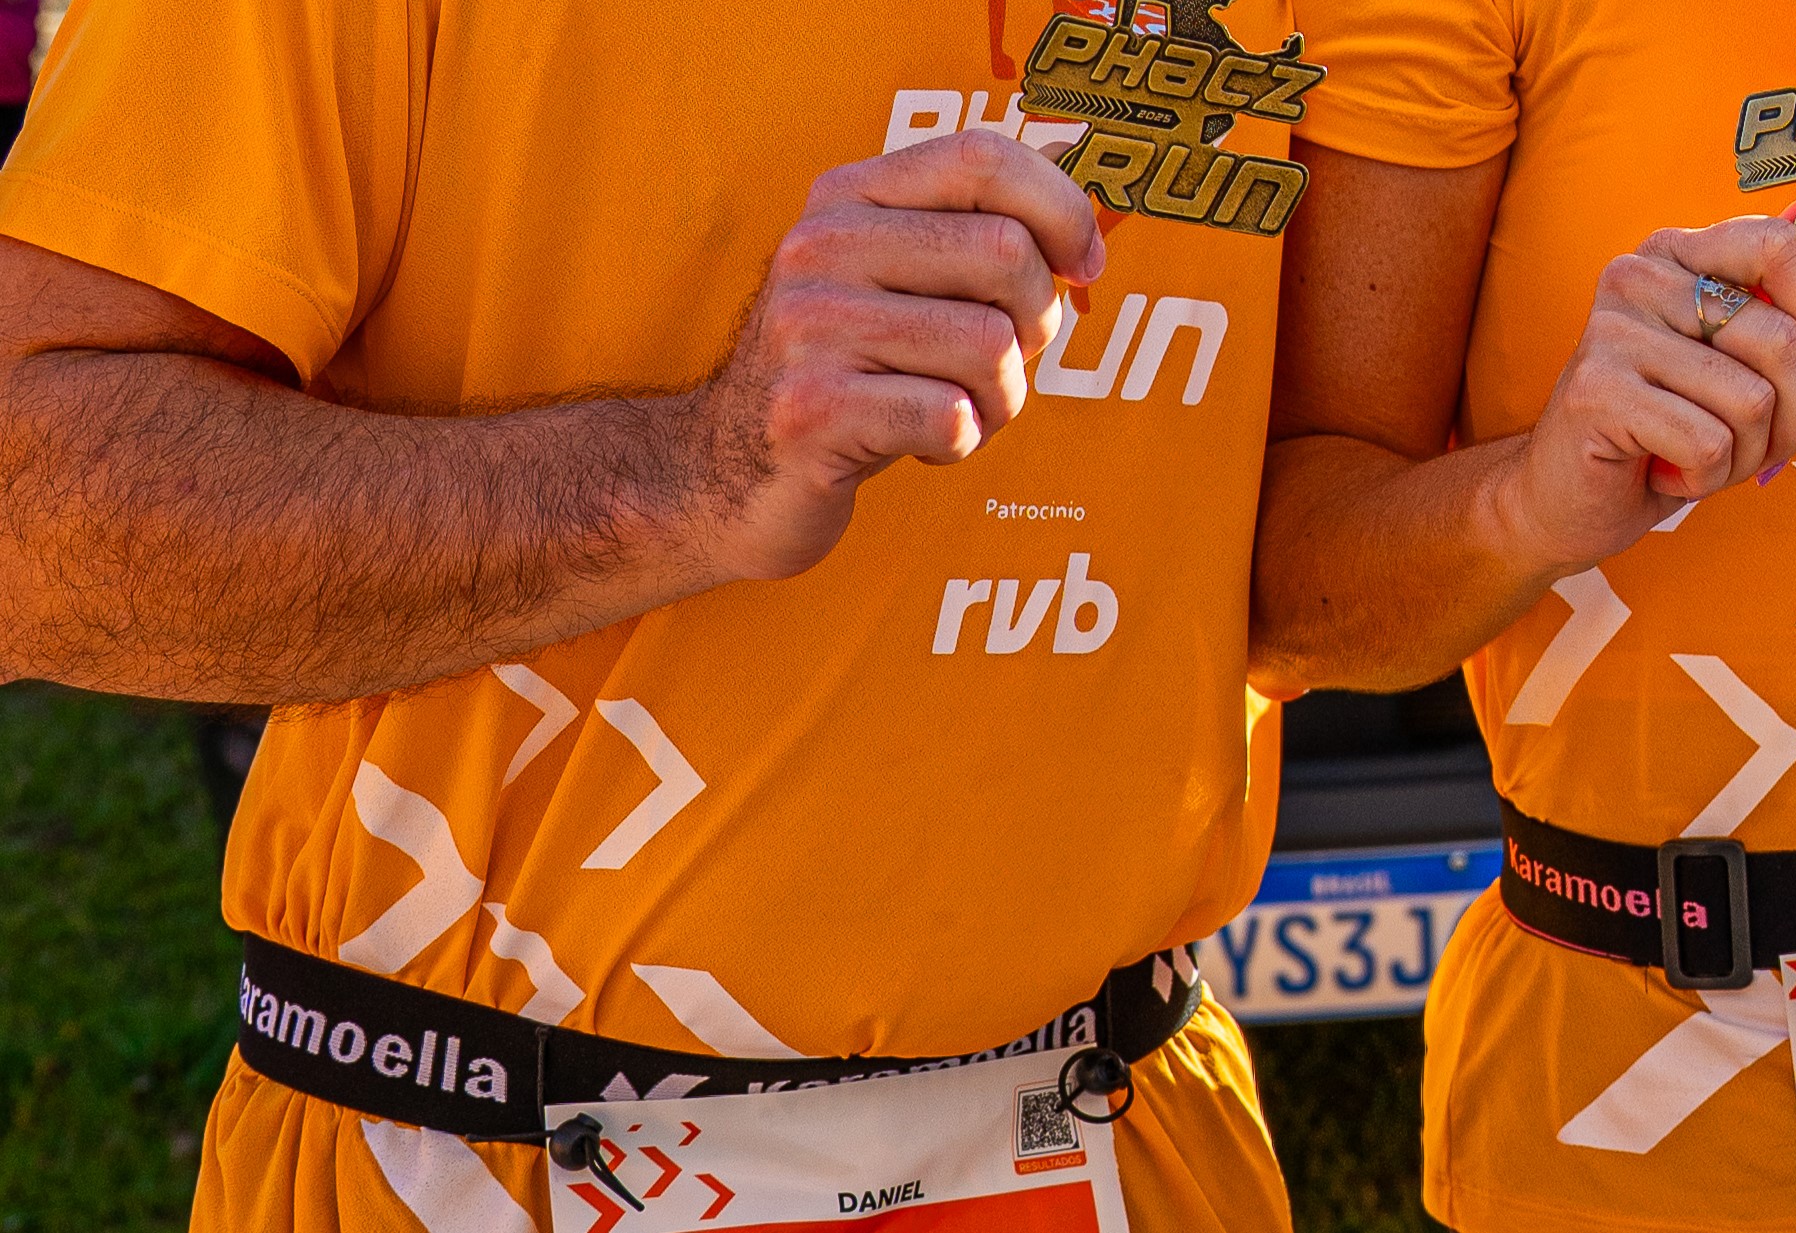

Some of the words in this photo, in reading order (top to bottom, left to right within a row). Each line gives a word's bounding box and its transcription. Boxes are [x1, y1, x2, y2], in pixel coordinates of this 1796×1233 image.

[1137, 108, 1173, 124] 2025
[985, 498, 1086, 522] Patrocinio
[932, 552, 1119, 655] rvb
[240, 962, 508, 1104] aramoella
[837, 1179, 926, 1214] DANIEL
